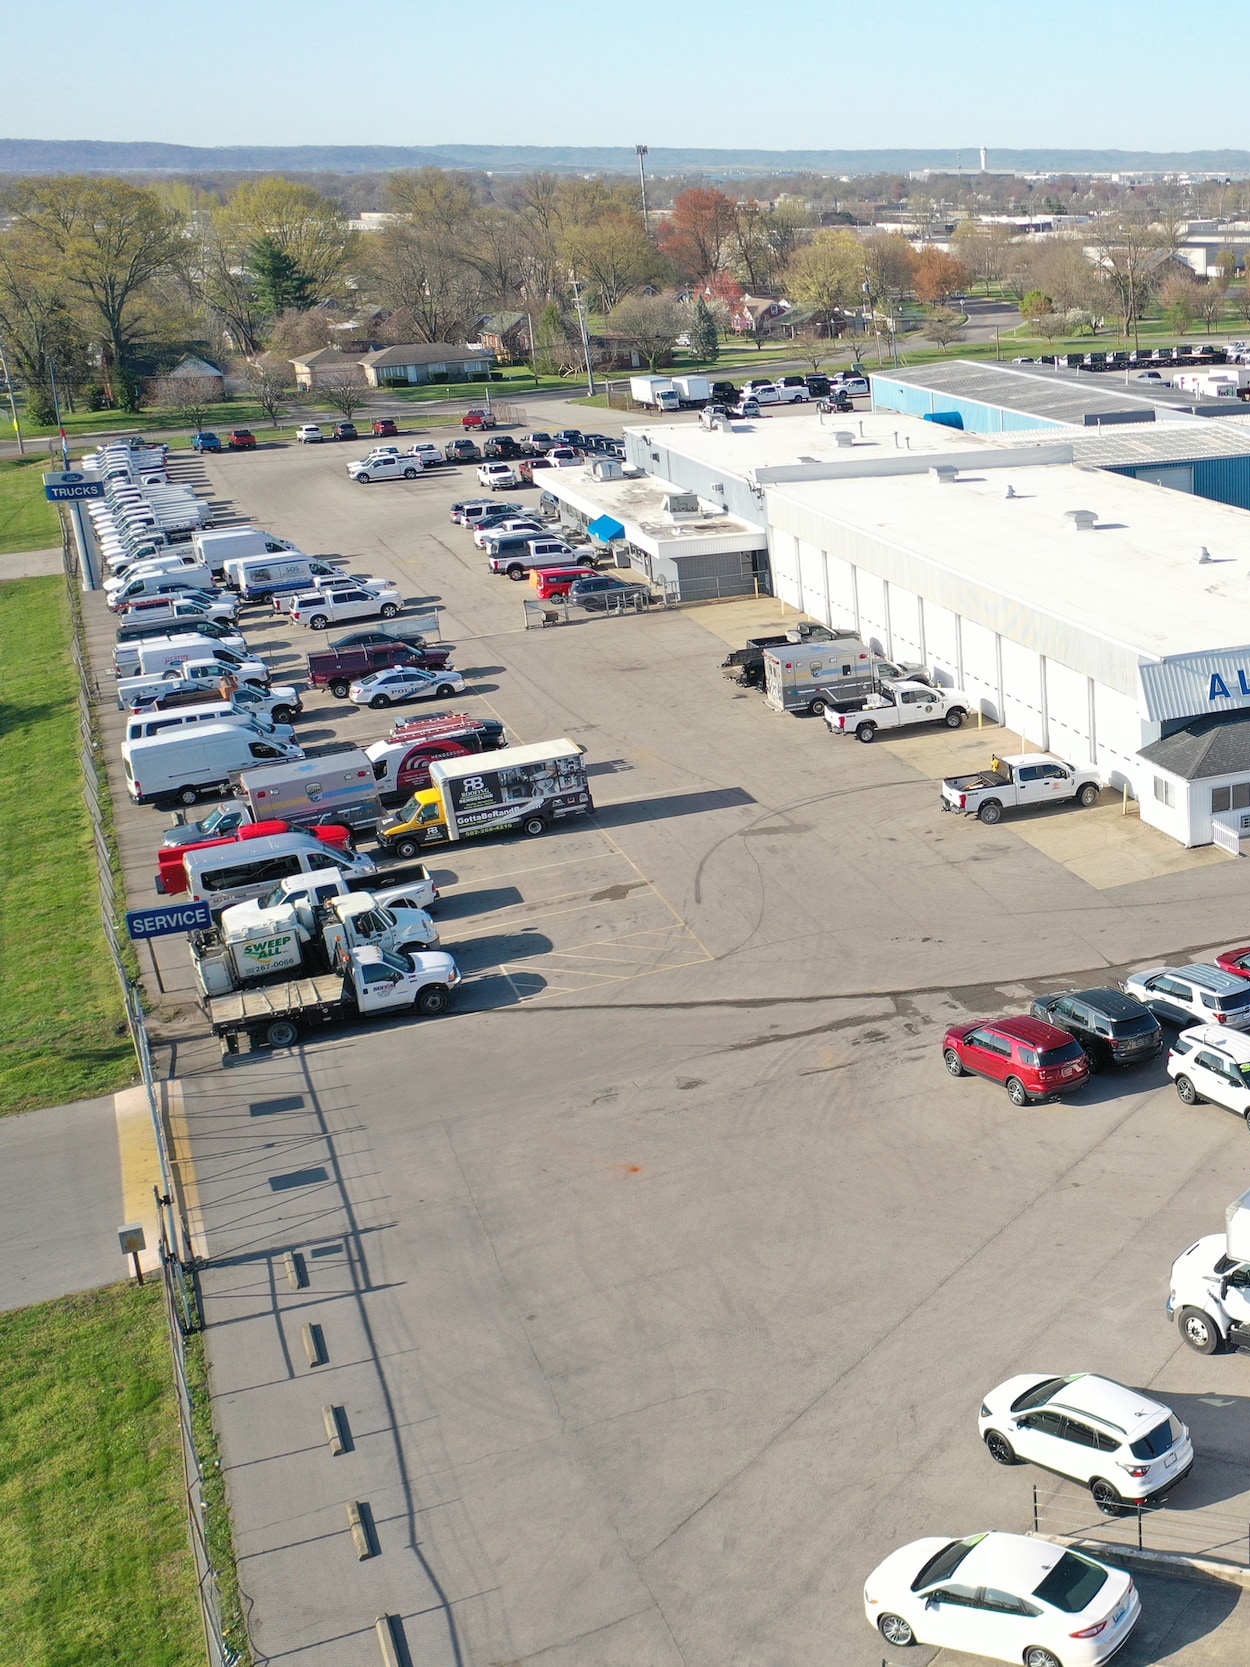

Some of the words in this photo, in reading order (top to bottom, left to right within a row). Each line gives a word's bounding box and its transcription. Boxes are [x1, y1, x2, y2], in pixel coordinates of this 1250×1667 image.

[51, 486, 99, 498] TRUCKS
[431, 749, 465, 759] HENDERSON
[459, 794, 493, 804] REMODELING
[461, 788, 490, 798] ROOFING
[132, 909, 207, 933] SERVICE
[244, 936, 291, 954] SWEEP
[257, 947, 282, 960] ALL
[255, 958, 295, 972] 267-0066
